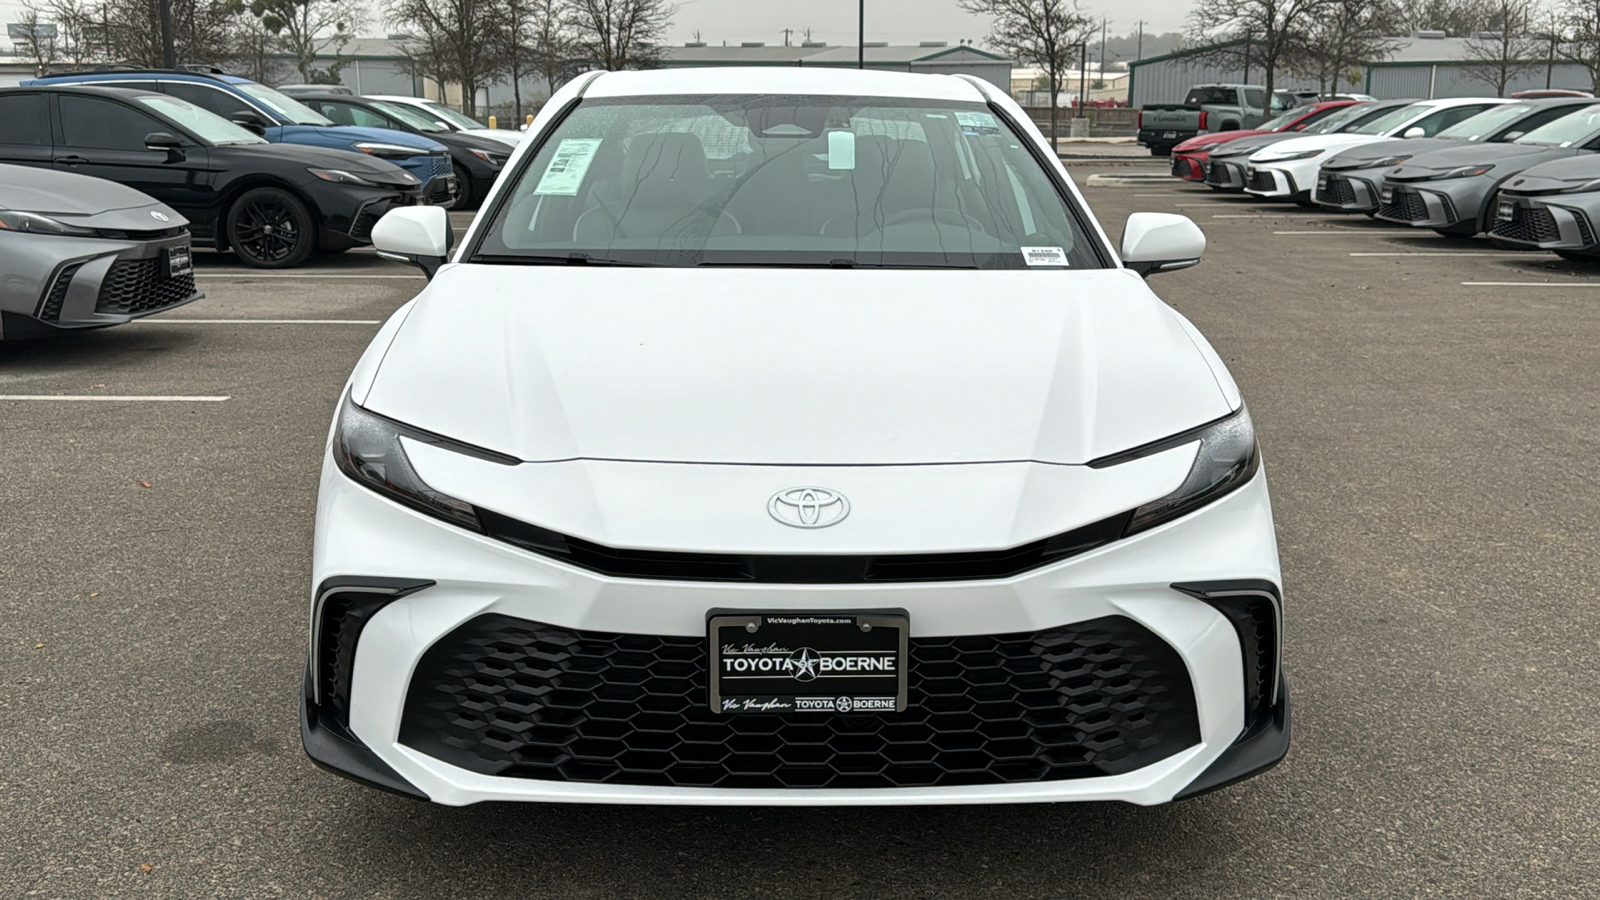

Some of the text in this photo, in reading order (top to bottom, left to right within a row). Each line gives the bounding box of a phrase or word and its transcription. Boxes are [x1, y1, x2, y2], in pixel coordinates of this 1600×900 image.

[767, 617, 851, 625] VicVaughanToyota.com
[742, 642, 790, 655] Vaughan
[723, 658, 794, 671] TOYOTA
[820, 657, 896, 671] BOERNE
[722, 698, 741, 711] Vic
[742, 698, 792, 712] Vaughan
[795, 700, 835, 709] TOYOTA
[853, 700, 896, 709] BOERNE
